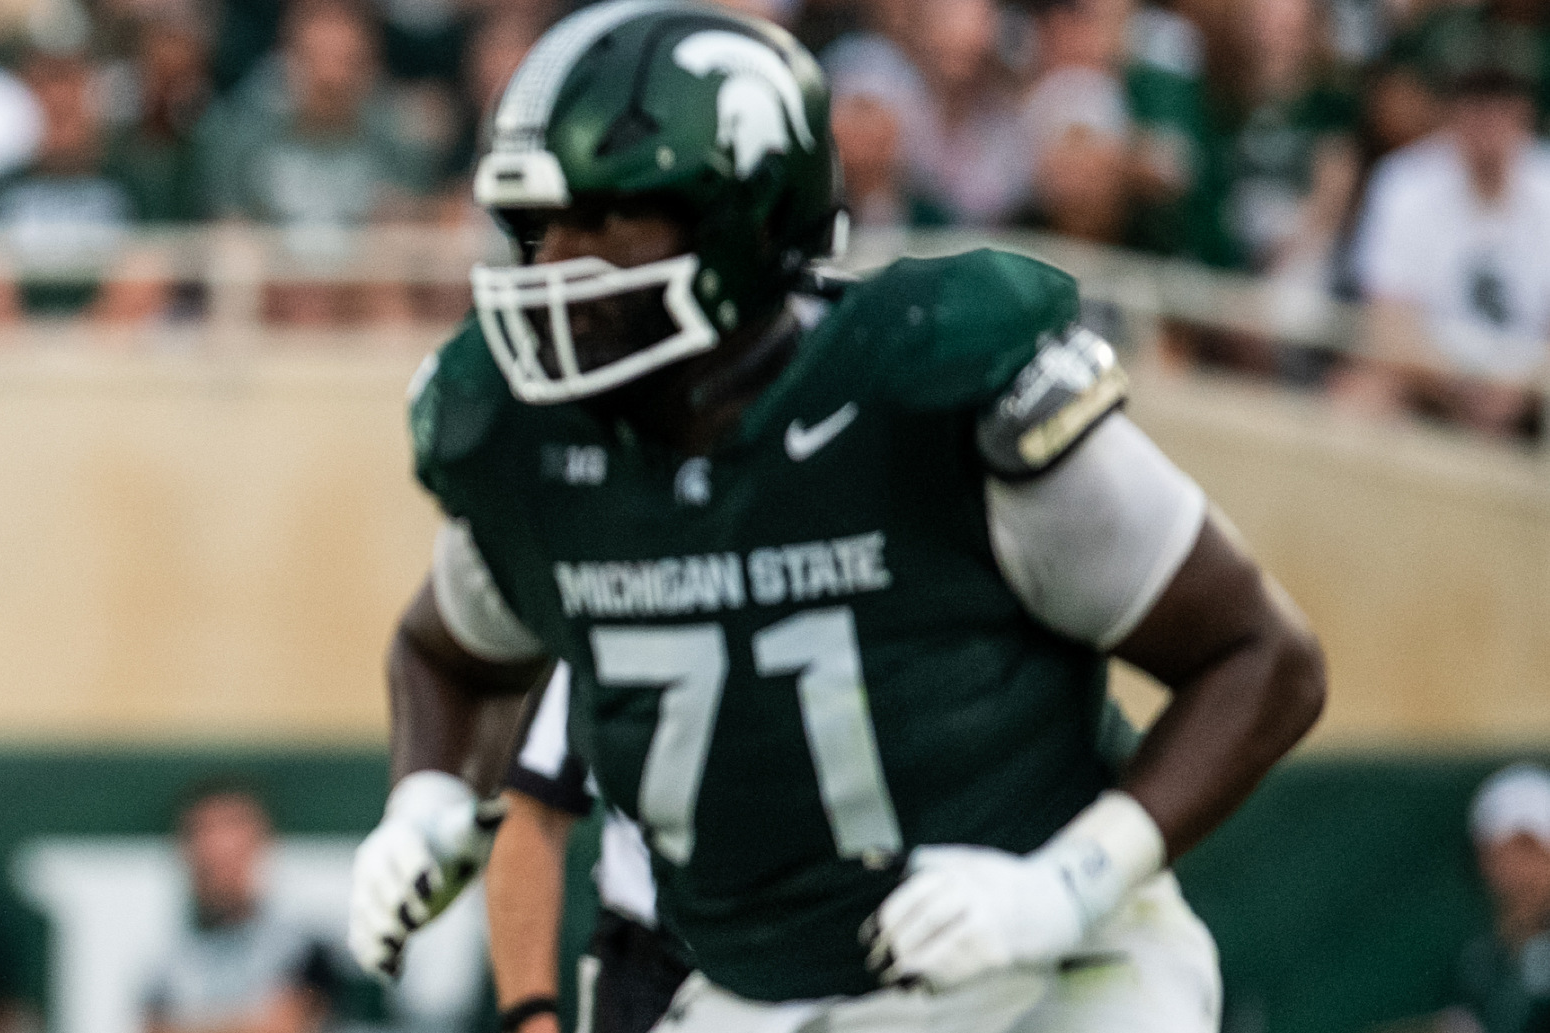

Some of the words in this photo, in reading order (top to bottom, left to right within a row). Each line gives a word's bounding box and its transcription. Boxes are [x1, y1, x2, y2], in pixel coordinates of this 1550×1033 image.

[554, 551, 747, 617] MICHIGAN
[748, 530, 893, 605] STATE
[589, 604, 905, 868] 71
